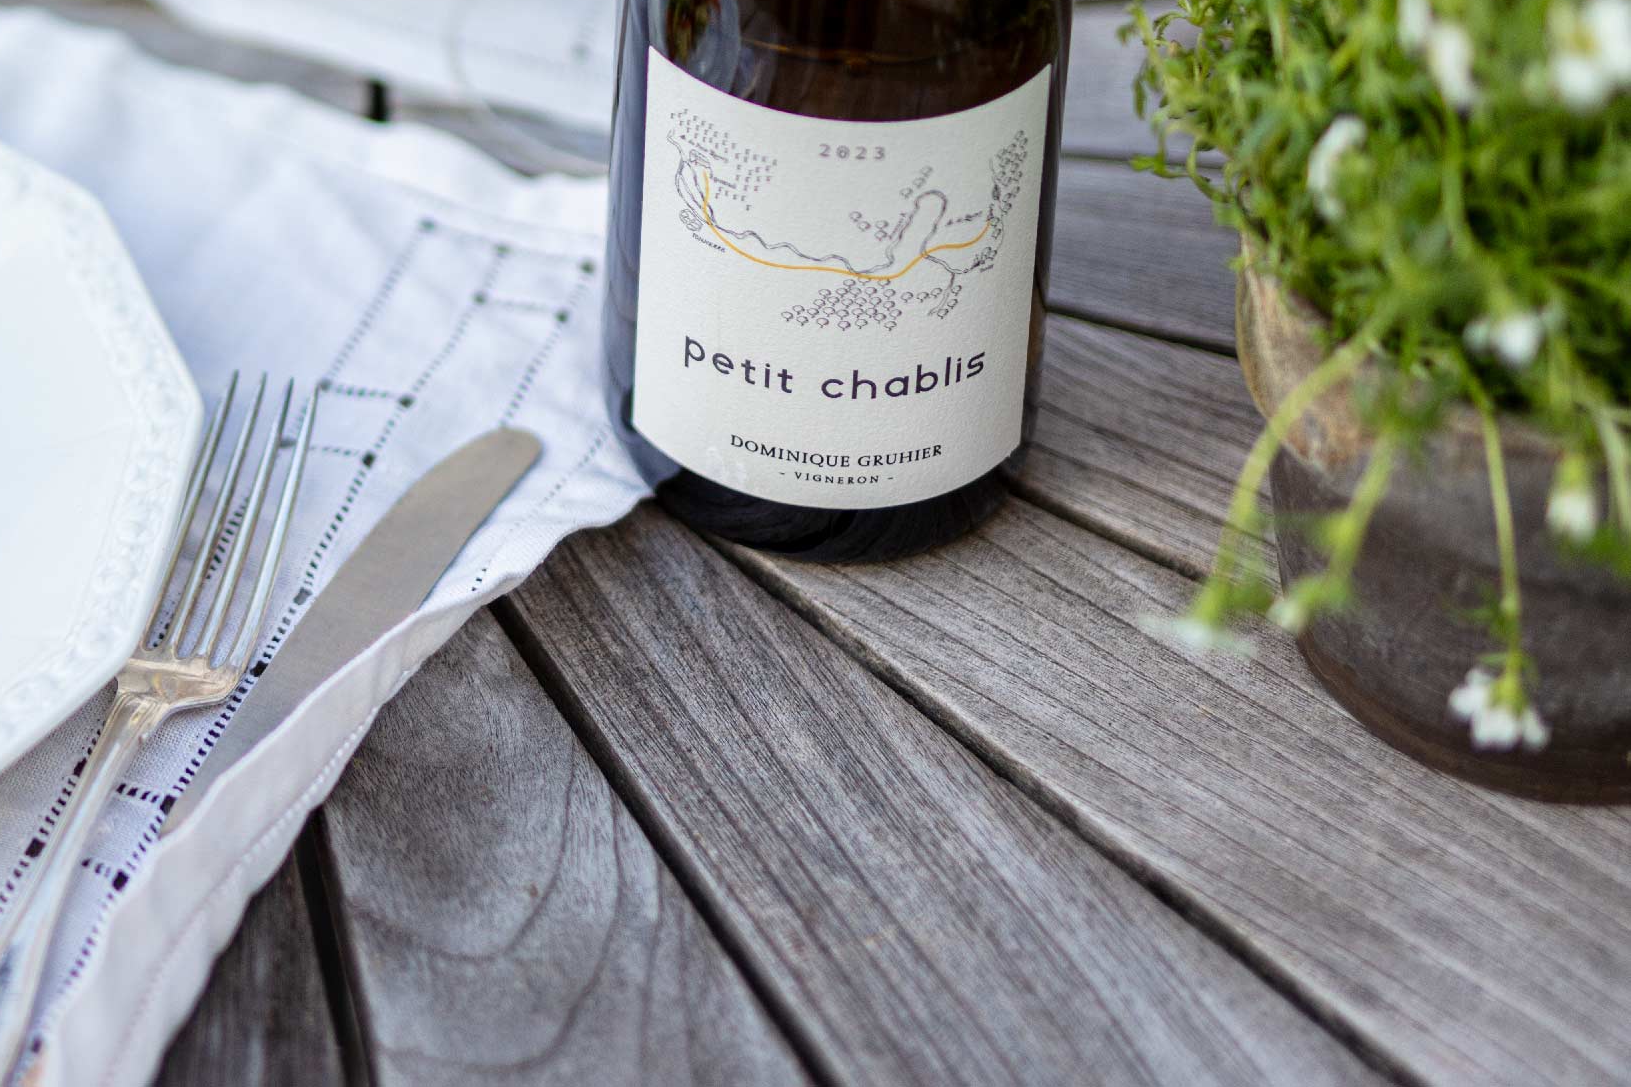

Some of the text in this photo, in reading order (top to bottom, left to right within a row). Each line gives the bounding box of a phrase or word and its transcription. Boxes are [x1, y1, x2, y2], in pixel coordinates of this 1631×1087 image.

[818, 143, 886, 161] 2023
[684, 334, 986, 400] petit chablis
[730, 433, 943, 468] DOMINIQUE GRUHIER
[793, 470, 880, 486] VIGNERON
